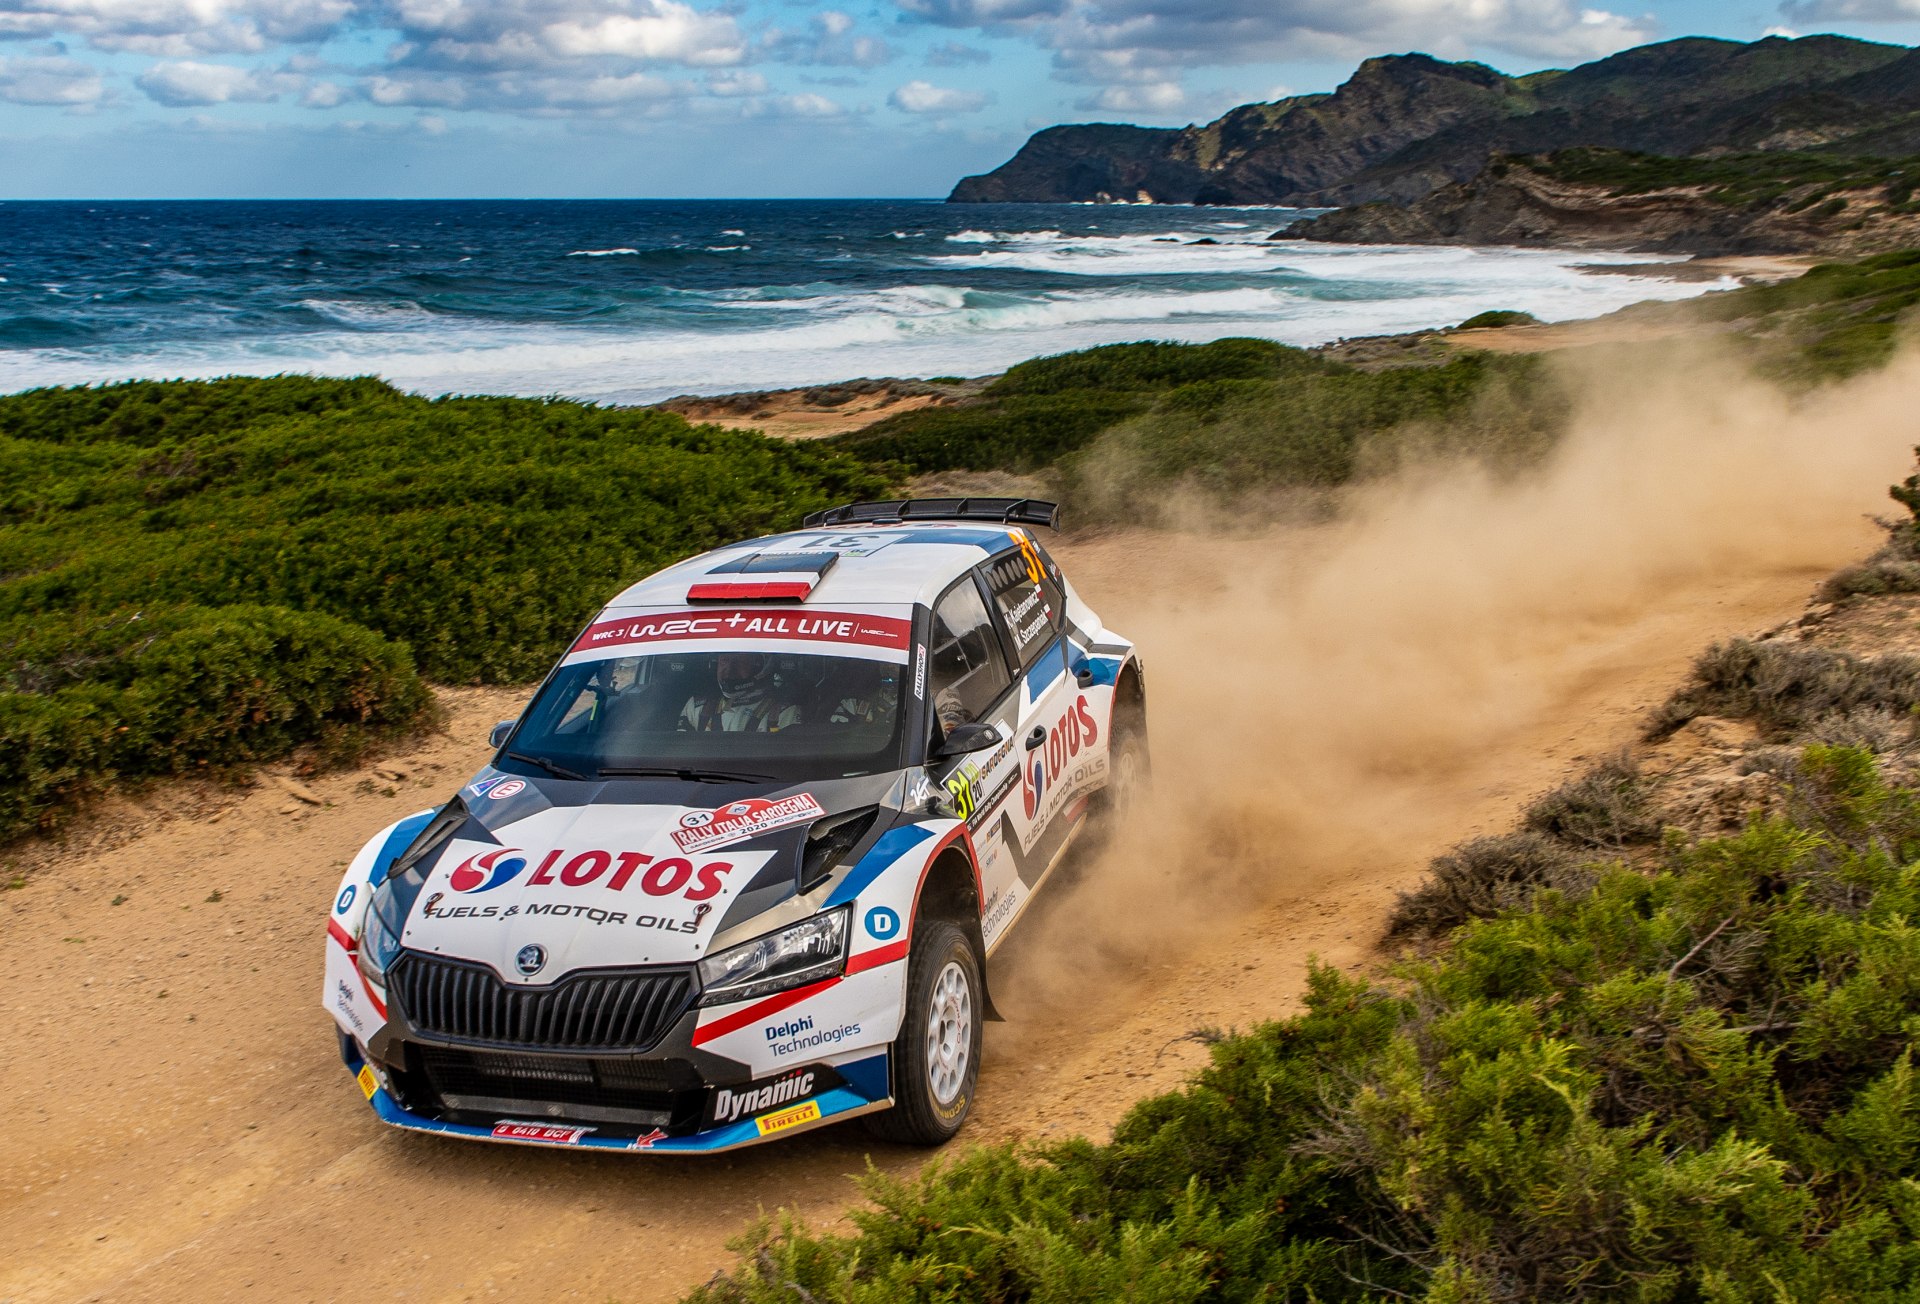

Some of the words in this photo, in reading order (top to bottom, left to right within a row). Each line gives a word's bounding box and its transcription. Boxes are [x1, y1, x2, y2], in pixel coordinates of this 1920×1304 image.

[592, 631, 614, 641] WRC
[615, 628, 624, 637] 3
[744, 617, 790, 633] ALL
[797, 619, 854, 637] LIVE
[1044, 694, 1098, 793] LOTOS
[1074, 758, 1106, 783] OILS
[947, 770, 975, 821] 31
[1023, 812, 1045, 846] FUELS
[1049, 776, 1073, 812] MOTOR
[678, 823, 717, 847] RALLY
[715, 813, 755, 835] ITALIA
[752, 794, 814, 823] SARDEGNA
[686, 813, 710, 827] 31
[740, 822, 768, 834] 2020
[524, 849, 734, 901] LOTOS
[424, 905, 501, 920] FUELS
[503, 904, 521, 917] &
[525, 903, 629, 925] MOTOR
[635, 914, 699, 935] OILS
[873, 913, 892, 933] D
[982, 889, 1017, 938] echnologies
[765, 1015, 814, 1041] Delphi
[769, 1022, 862, 1057] Technologies
[713, 1071, 815, 1123] Dynamic
[762, 1104, 815, 1131] PIRELLI
